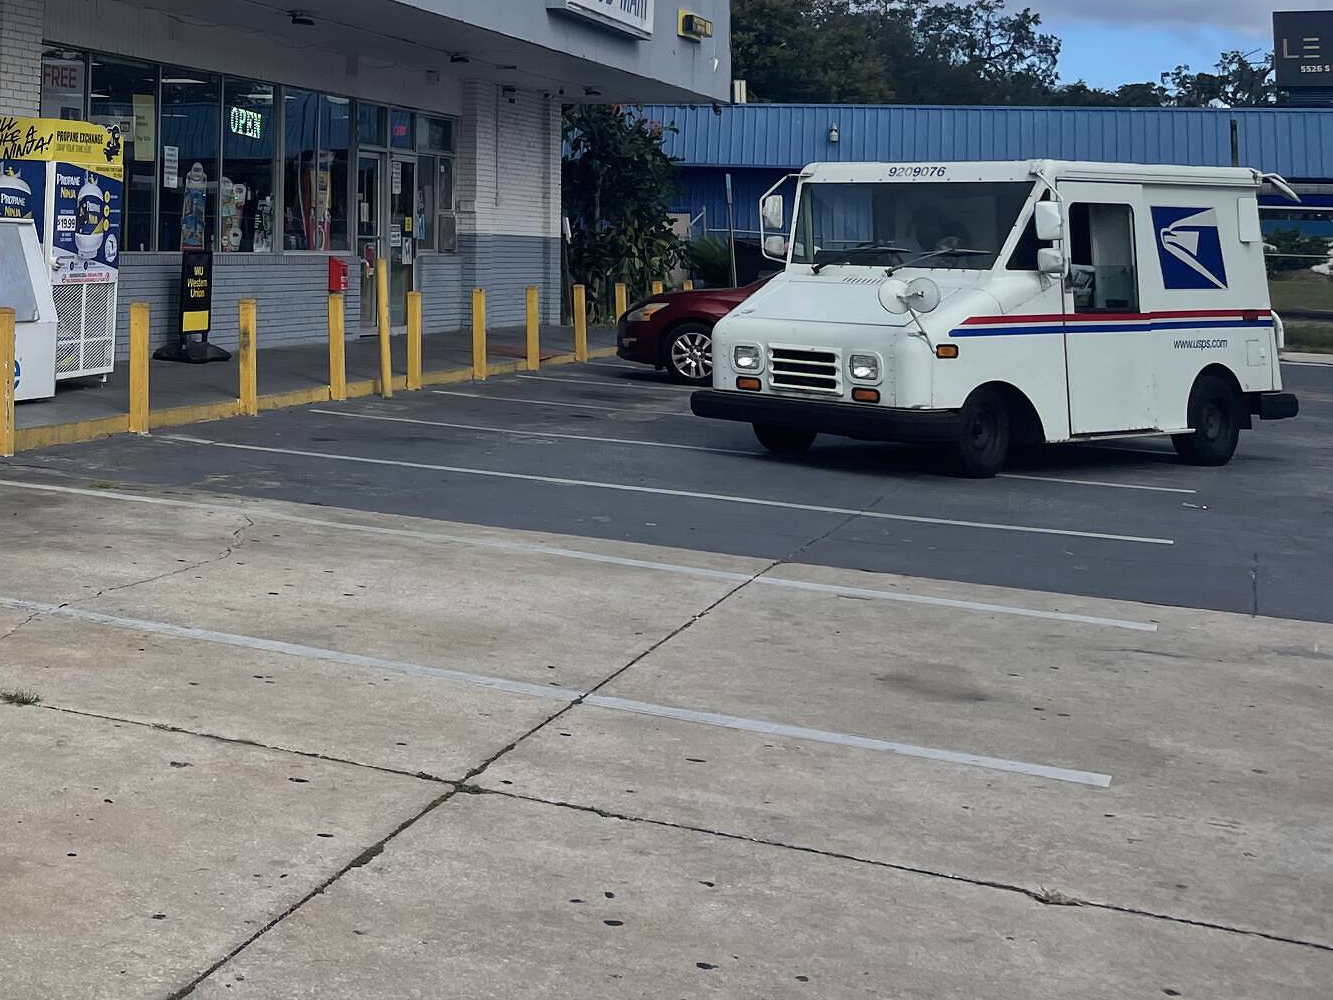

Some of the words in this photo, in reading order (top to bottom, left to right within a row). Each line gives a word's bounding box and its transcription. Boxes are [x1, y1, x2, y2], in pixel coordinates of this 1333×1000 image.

[1300, 64, 1323, 73] 5526
[43, 63, 77, 89] FREE
[230, 106, 262, 139] OPEN
[26, 126, 38, 140] A
[56, 130, 79, 143] PROPANE
[79, 132, 104, 145] EXCHANGE
[3, 133, 53, 159] NINJA!
[888, 166, 947, 177] 9209076
[56, 173, 80, 186] PROPANE
[60, 186, 76, 198] NINJA
[0, 193, 26, 206] PROPANE
[4, 205, 21, 217] NINJA
[187, 278, 208, 288] Western
[190, 288, 205, 298] Union
[1173, 339, 1228, 351] www.usps.com
